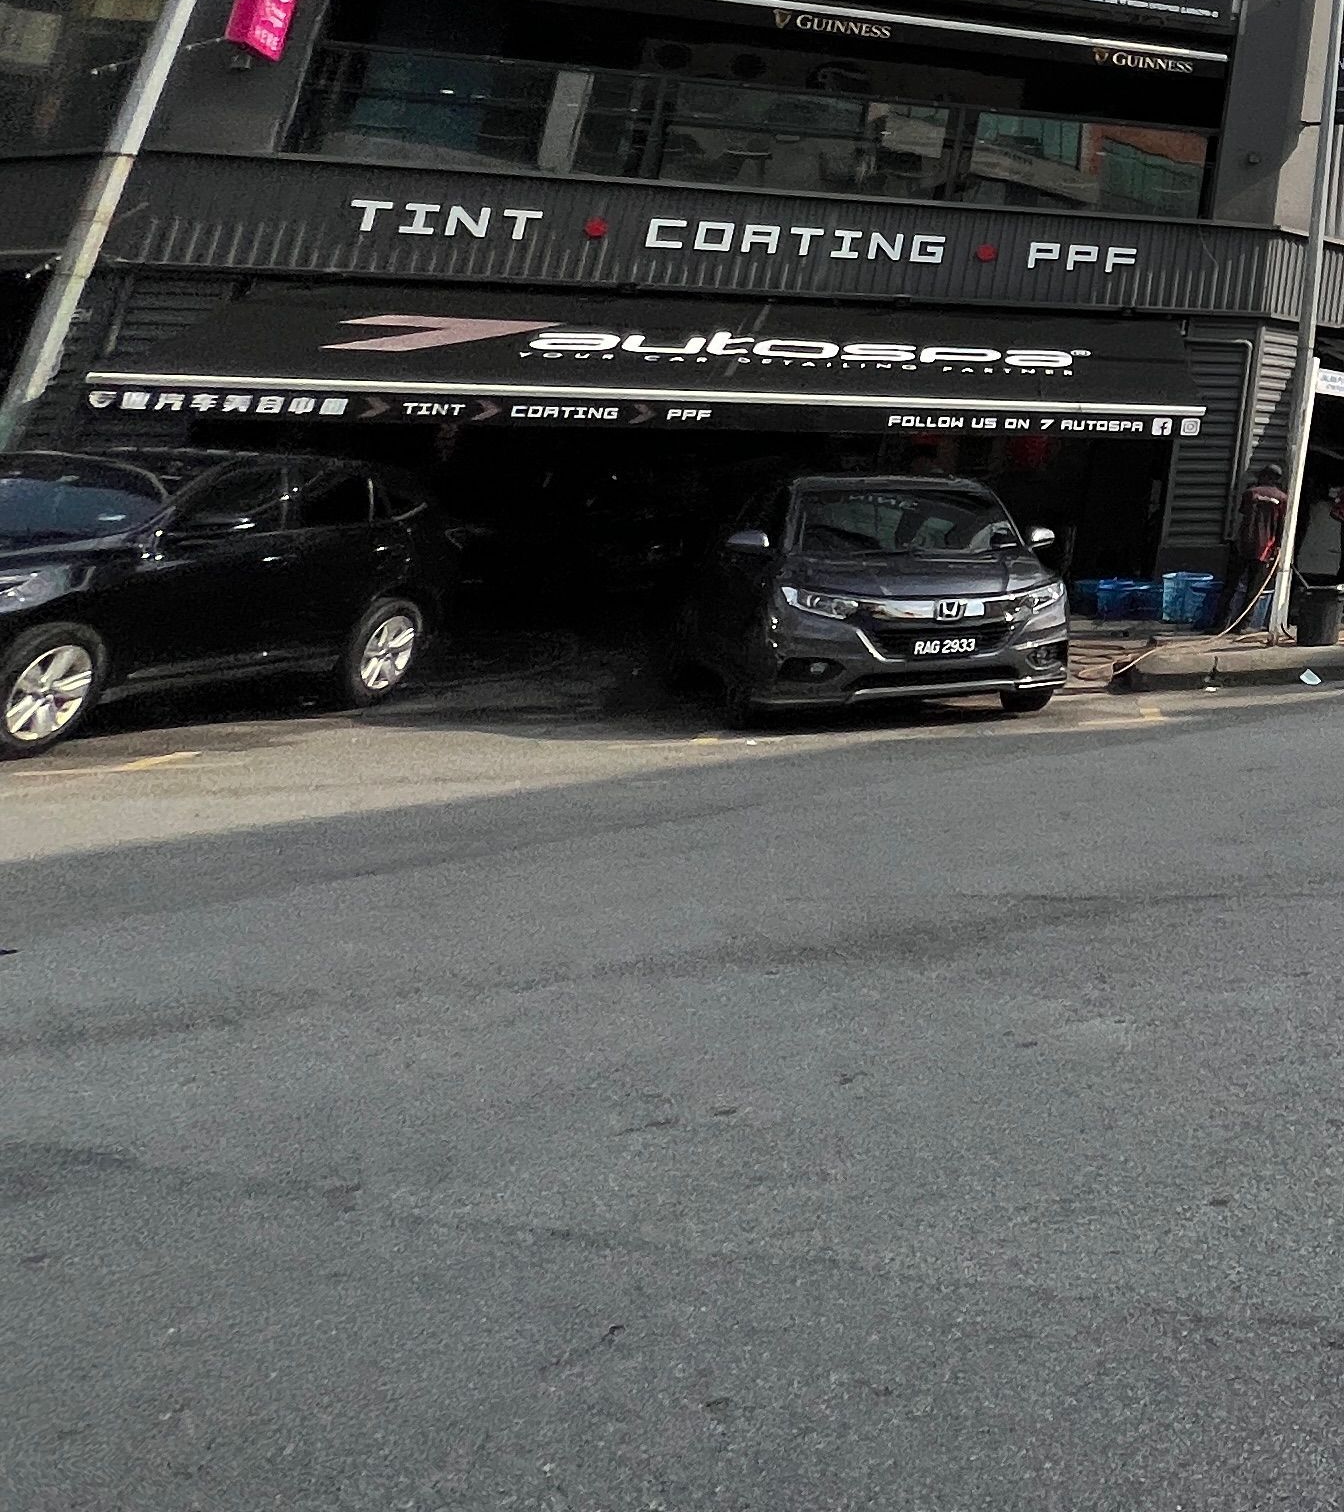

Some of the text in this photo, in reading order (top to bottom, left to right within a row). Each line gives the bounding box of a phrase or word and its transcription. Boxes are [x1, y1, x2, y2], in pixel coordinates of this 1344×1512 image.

[796, 13, 892, 40] GUINNESS
[1111, 50, 1194, 74] GUINNESS
[350, 199, 1138, 274] TINT COATING PPF
[519, 351, 614, 360] YOUR
[644, 354, 708, 363] CAR
[529, 331, 1073, 368] autospa
[402, 401, 466, 417] TINT
[510, 404, 619, 421] COATING
[666, 408, 712, 421] PPF
[888, 414, 1144, 433] FOLLOW US ON 7 AUTOSPA
[914, 638, 976, 656] RAG 2933
